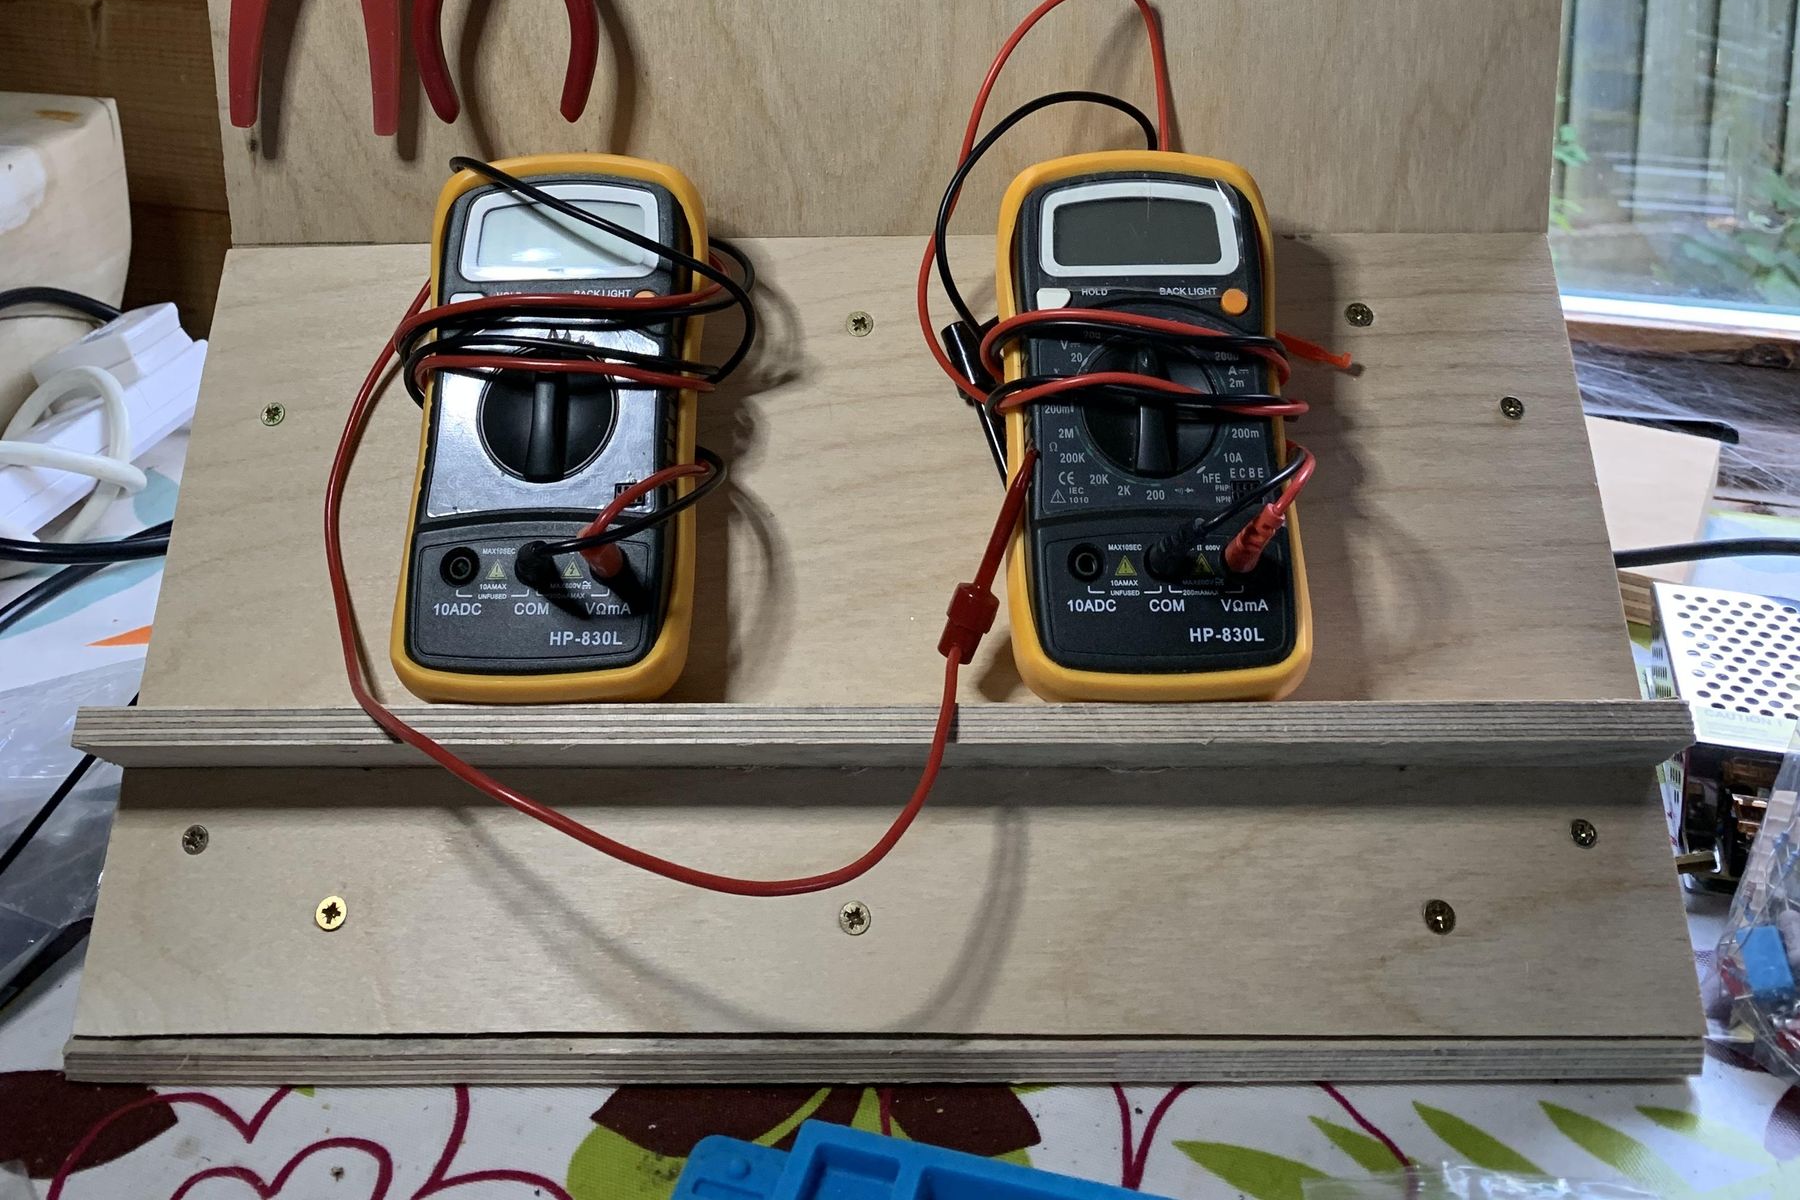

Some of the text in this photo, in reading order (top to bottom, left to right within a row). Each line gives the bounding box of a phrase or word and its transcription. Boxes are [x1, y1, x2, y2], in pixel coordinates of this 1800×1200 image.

[1081, 288, 1108, 296] HOLD
[1070, 352, 1083, 363] 20
[1229, 378, 1245, 388] 2m
[1058, 428, 1074, 439] 2M
[1231, 427, 1260, 439] 200m
[1060, 452, 1085, 463] 200K
[1223, 452, 1243, 463] 10A
[1089, 473, 1109, 485] 20K
[1202, 473, 1222, 484] hFE
[1069, 486, 1085, 495] IEC
[1117, 485, 1131, 496] 2K
[1146, 489, 1165, 501] 200
[1069, 496, 1089, 504] 1010
[482, 547, 516, 555] MAX10SEC
[433, 603, 482, 616] 10ADC
[514, 602, 549, 615] COM
[585, 602, 632, 615] VΩmA
[1067, 599, 1117, 612] 10ADC
[1149, 599, 1185, 612] COM
[1221, 599, 1269, 612] VΩmA
[549, 631, 623, 646] HP-830L
[1189, 627, 1264, 642] HP-830L
